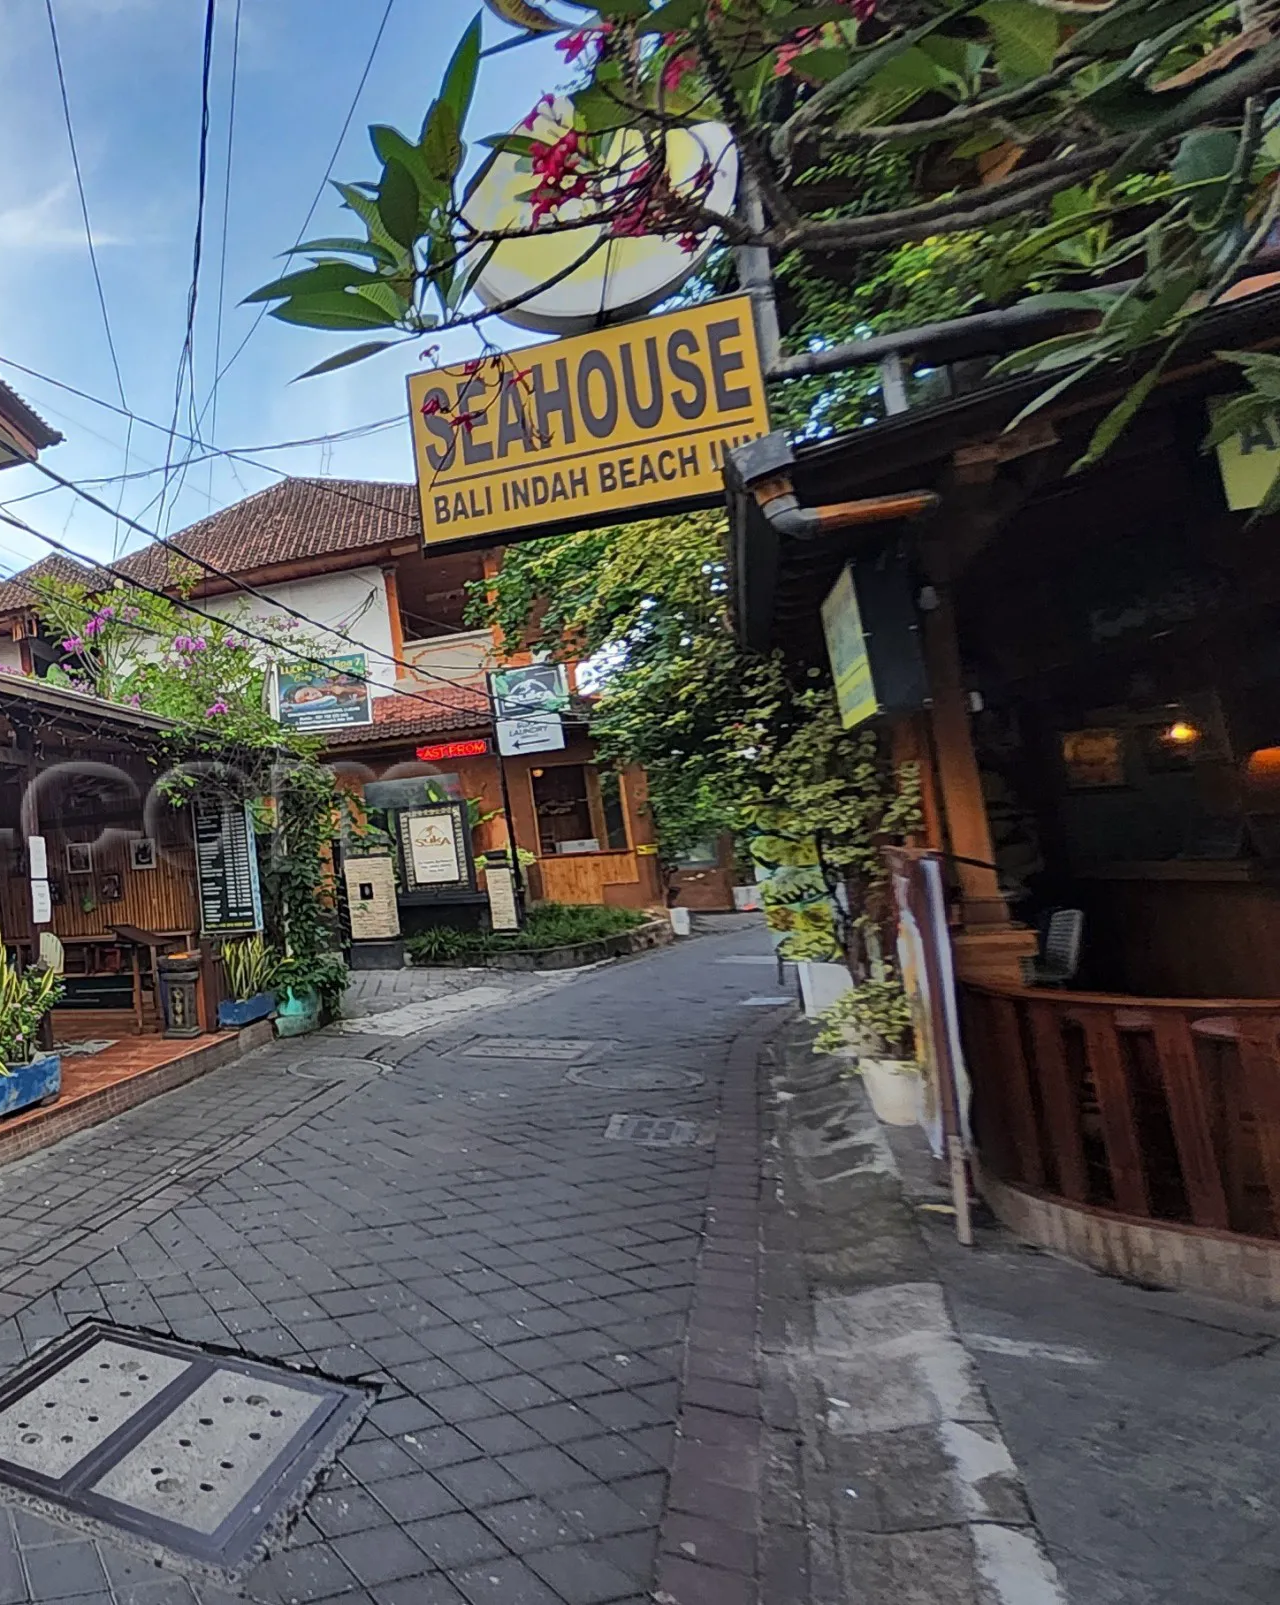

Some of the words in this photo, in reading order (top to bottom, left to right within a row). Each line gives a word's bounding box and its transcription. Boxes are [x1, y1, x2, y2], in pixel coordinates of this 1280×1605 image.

[423, 318, 753, 472] SEAHOUSE
[434, 485, 493, 525] BALI
[502, 466, 589, 512] INDAH
[598, 444, 700, 493] BEACH
